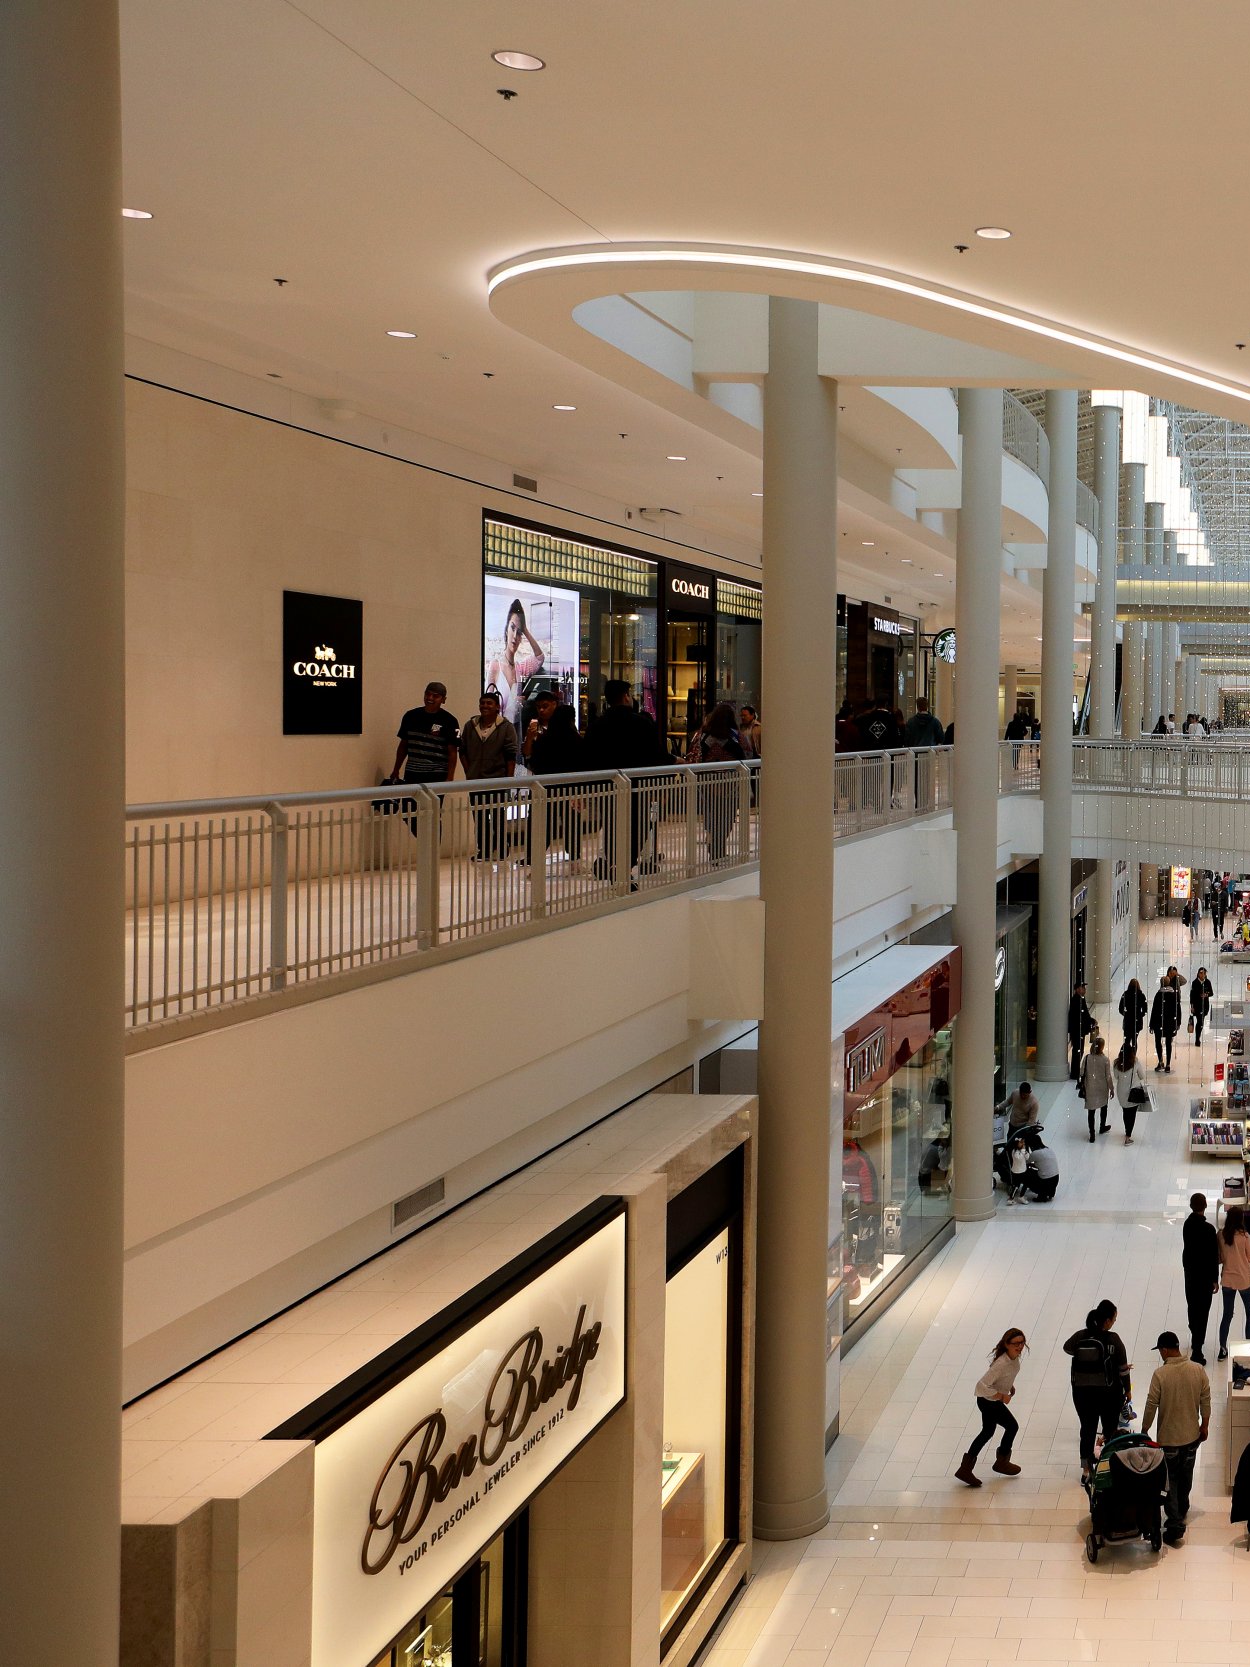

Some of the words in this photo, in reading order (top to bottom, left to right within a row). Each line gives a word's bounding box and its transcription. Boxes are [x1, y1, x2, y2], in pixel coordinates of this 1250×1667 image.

[672, 578, 709, 600] COACH
[874, 617, 900, 636] STARBUCKS
[293, 661, 356, 679] COACH
[361, 1408, 479, 1576] Ben
[479, 1304, 602, 1467] Bridge
[398, 1540, 428, 1576] YOUR
[431, 1491, 481, 1547] PERSONAL
[483, 1450, 521, 1496] JEWELER
[523, 1426, 546, 1456] SINCE
[548, 1408, 565, 1431] 1912
